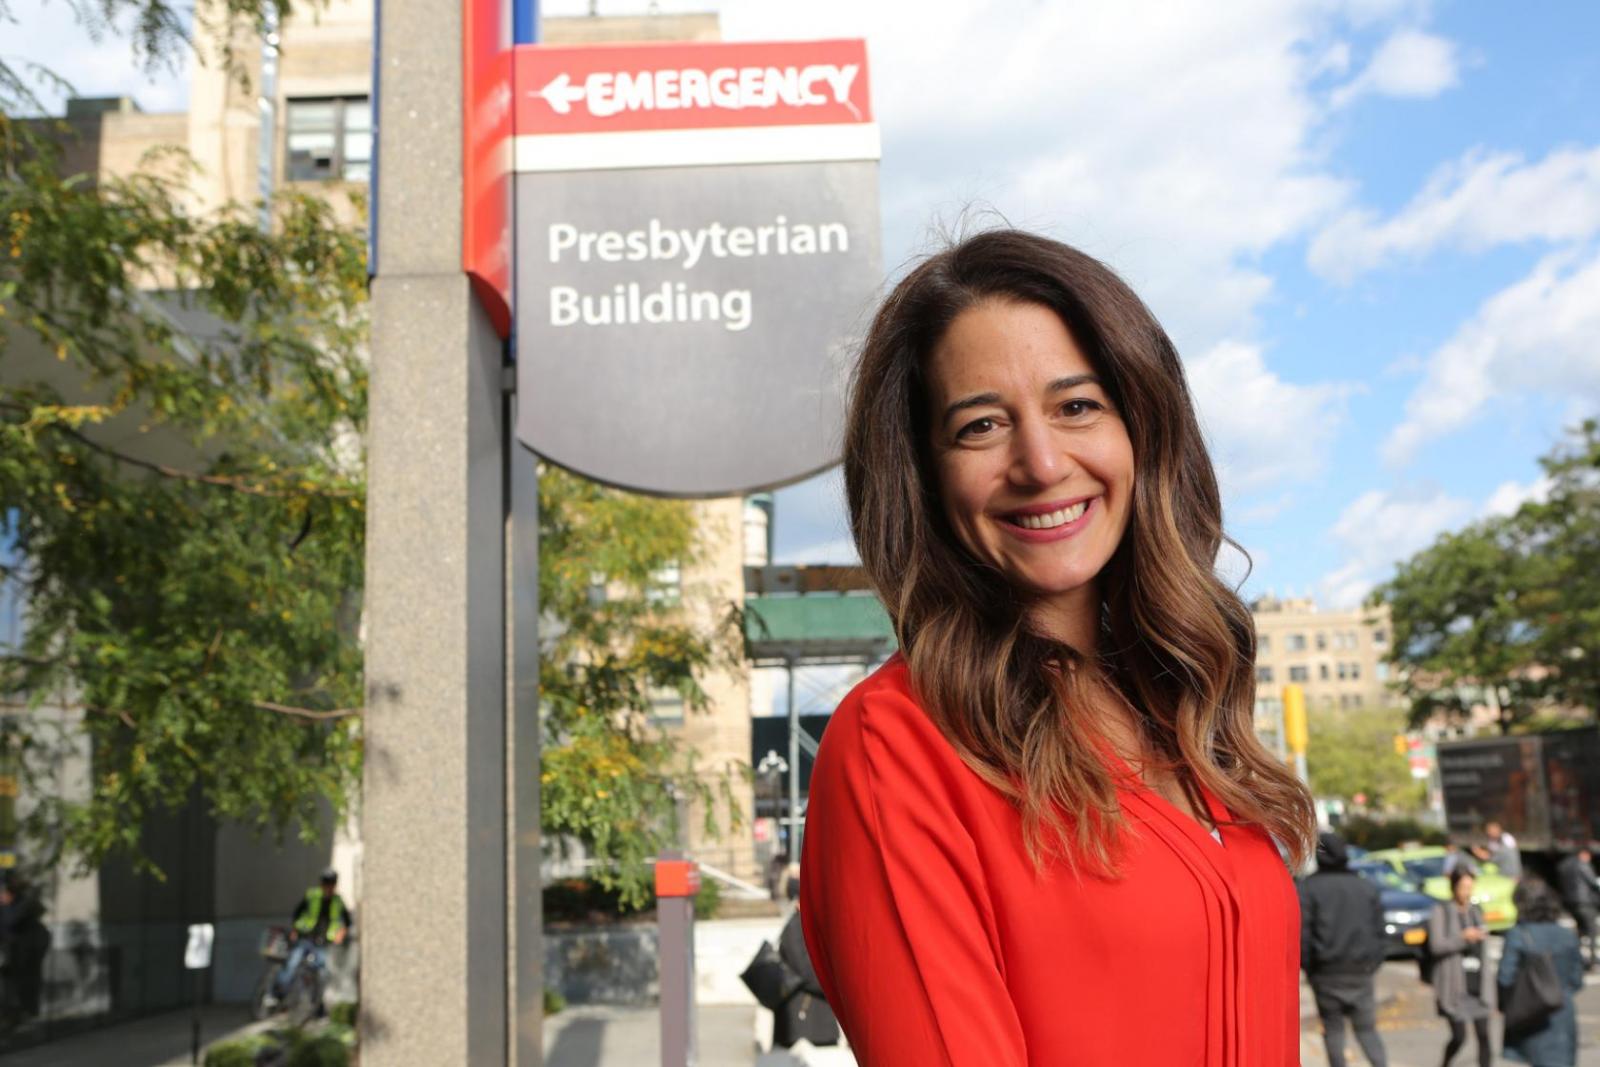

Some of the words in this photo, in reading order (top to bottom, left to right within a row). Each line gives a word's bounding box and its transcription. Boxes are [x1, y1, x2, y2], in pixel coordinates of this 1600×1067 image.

[586, 64, 859, 116] EMERGENCY
[549, 215, 848, 269] Presbyterian
[550, 282, 752, 331] Building
